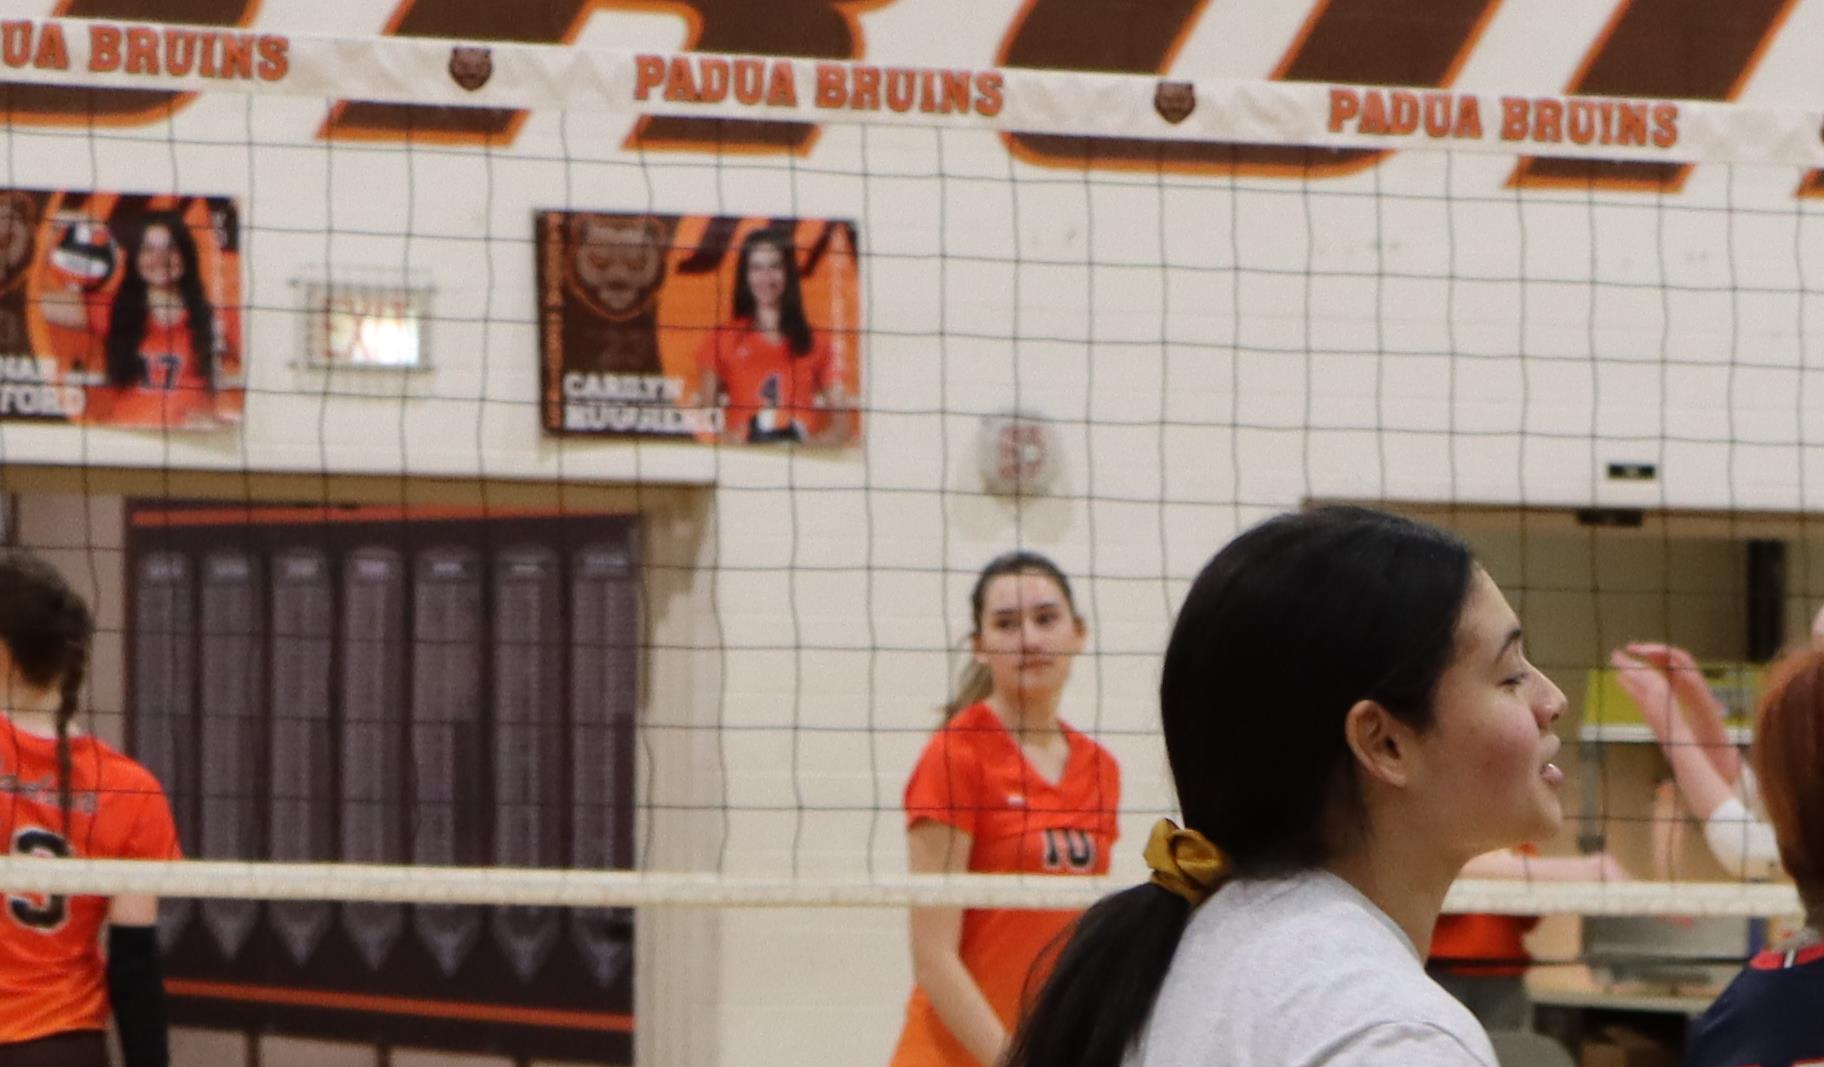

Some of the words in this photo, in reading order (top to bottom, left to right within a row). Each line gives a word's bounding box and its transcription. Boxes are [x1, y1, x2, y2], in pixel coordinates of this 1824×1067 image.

[88, 24, 290, 82] BRUINS
[634, 54, 797, 108] PADUA
[814, 63, 1004, 117] BRUINS
[1327, 88, 1483, 139] PADUA
[1501, 95, 1679, 148] BRUINS
